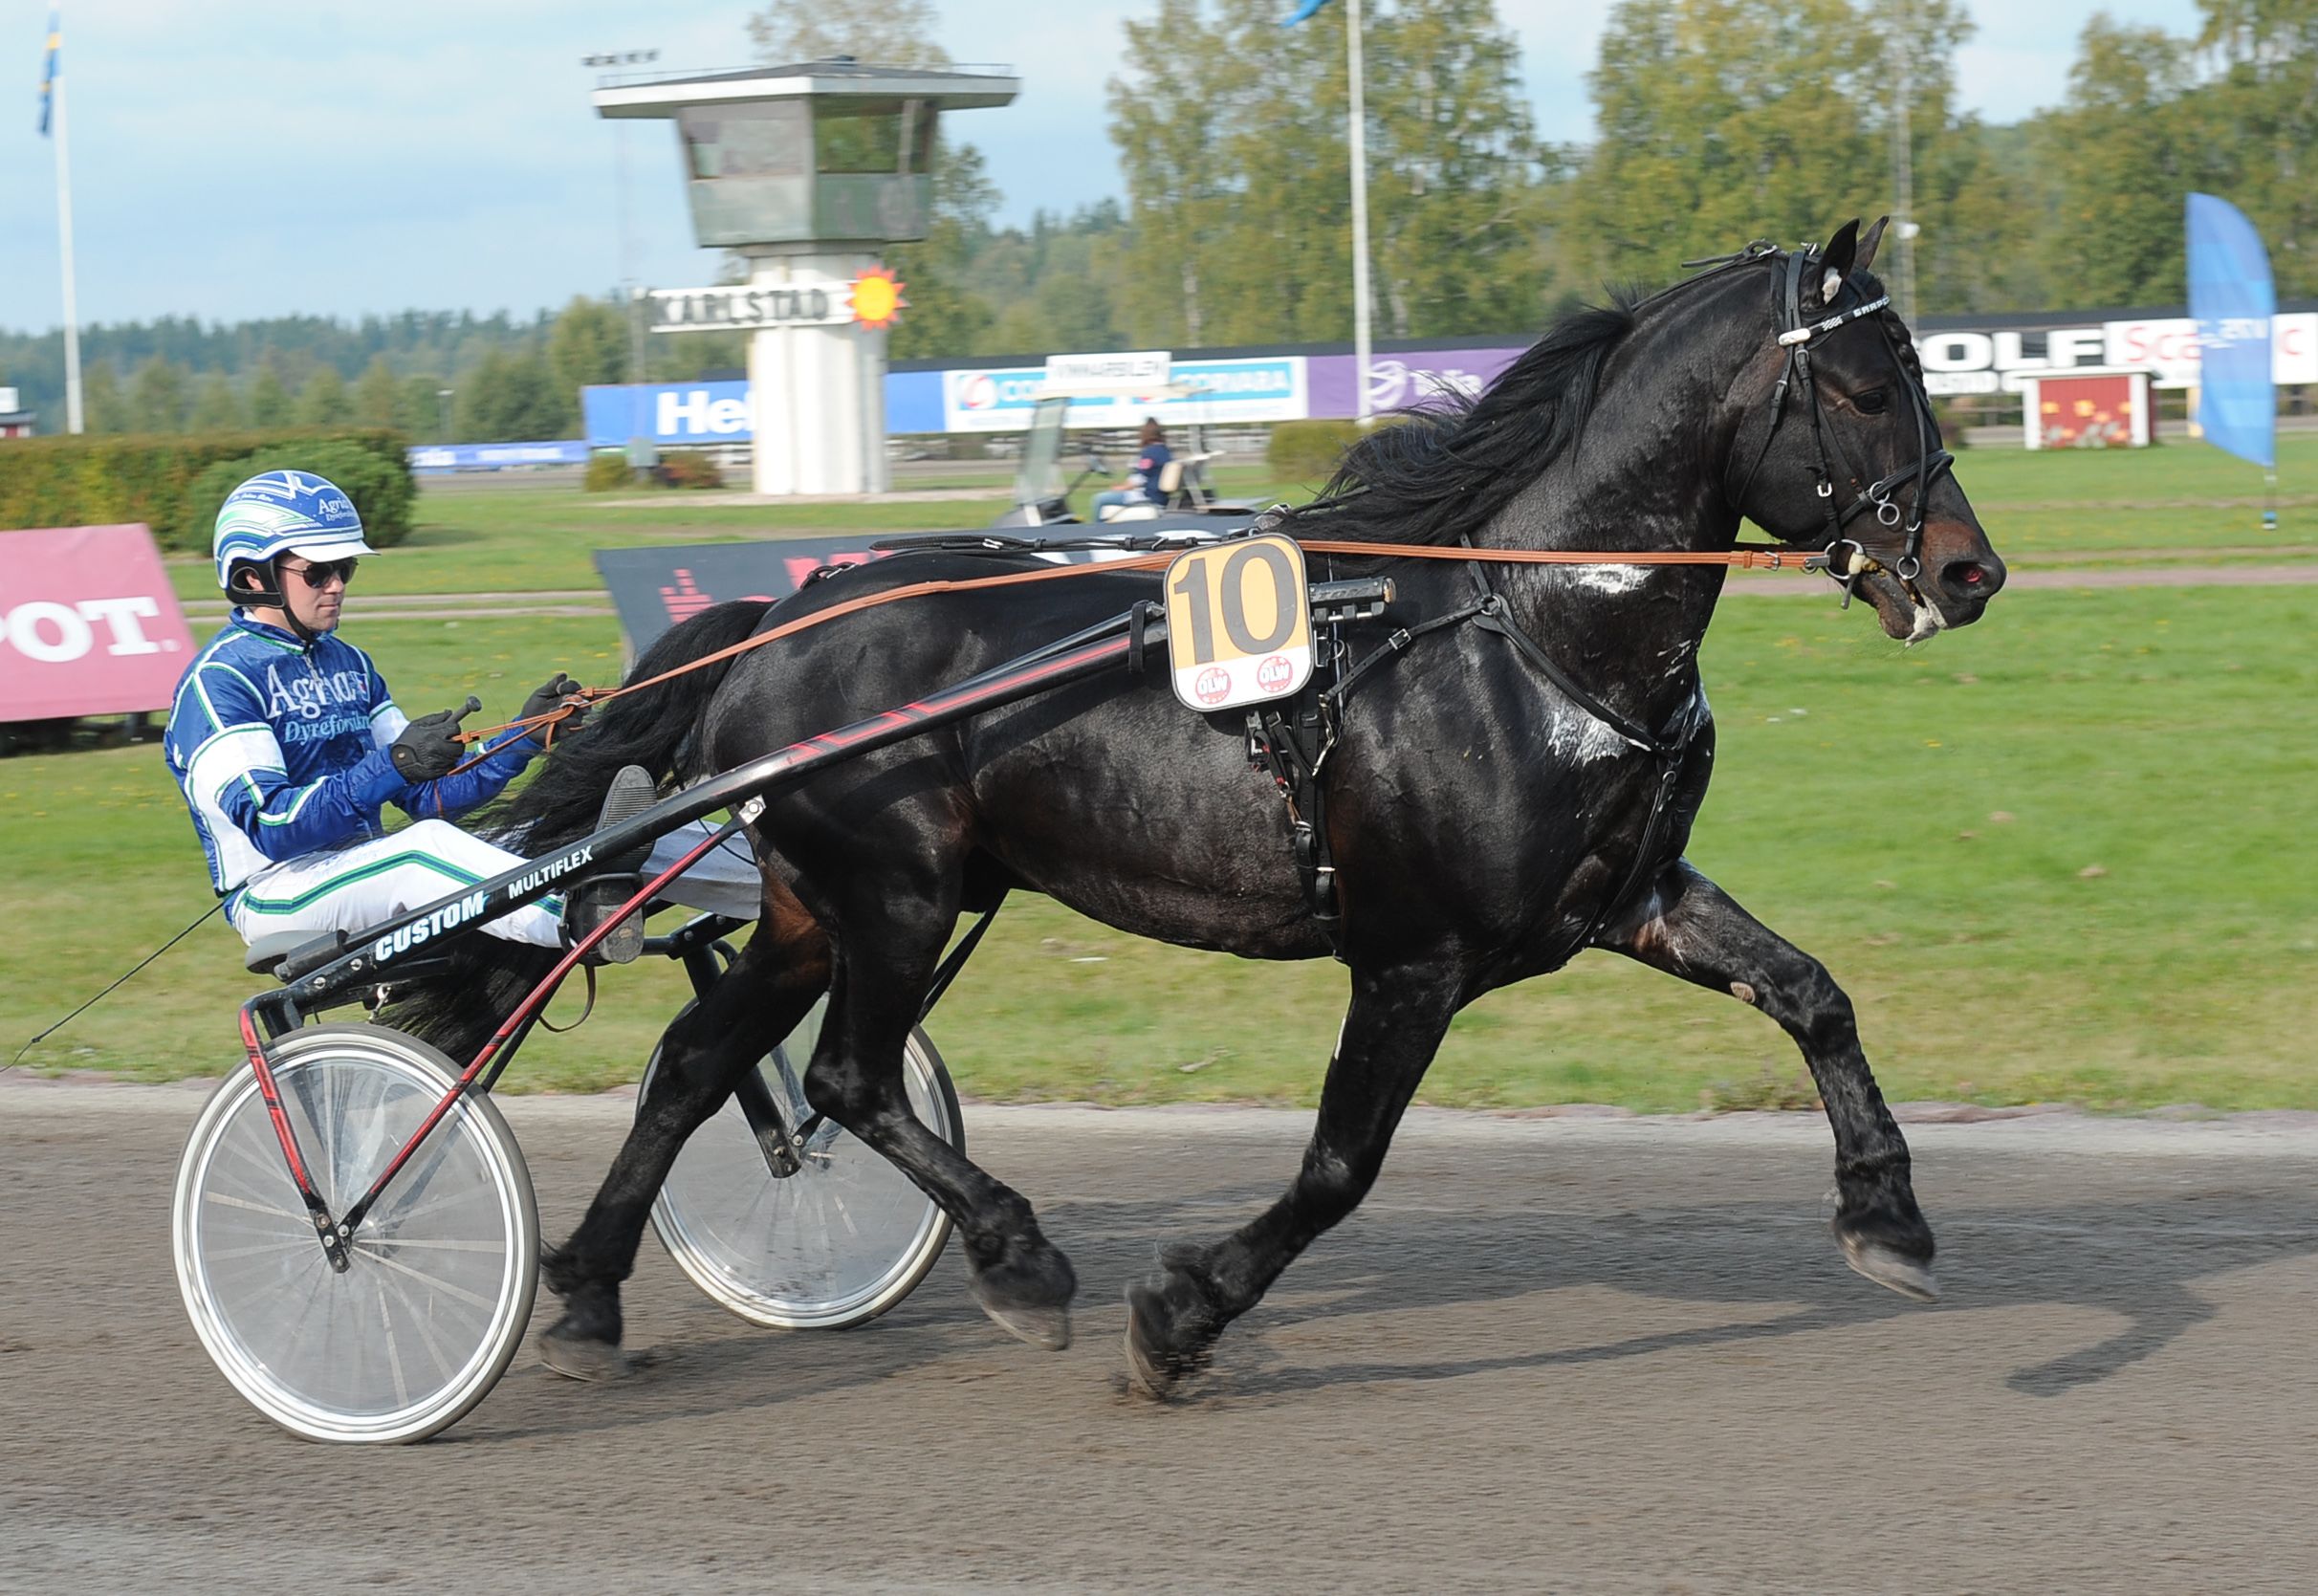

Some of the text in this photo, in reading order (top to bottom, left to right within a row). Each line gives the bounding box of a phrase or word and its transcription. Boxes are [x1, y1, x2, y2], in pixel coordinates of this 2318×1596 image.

[1913, 328, 2104, 371] OLF
[1173, 543, 1298, 666] 10
[508, 845, 594, 900] MULTIFLEX
[375, 890, 486, 962] CUSTOM
